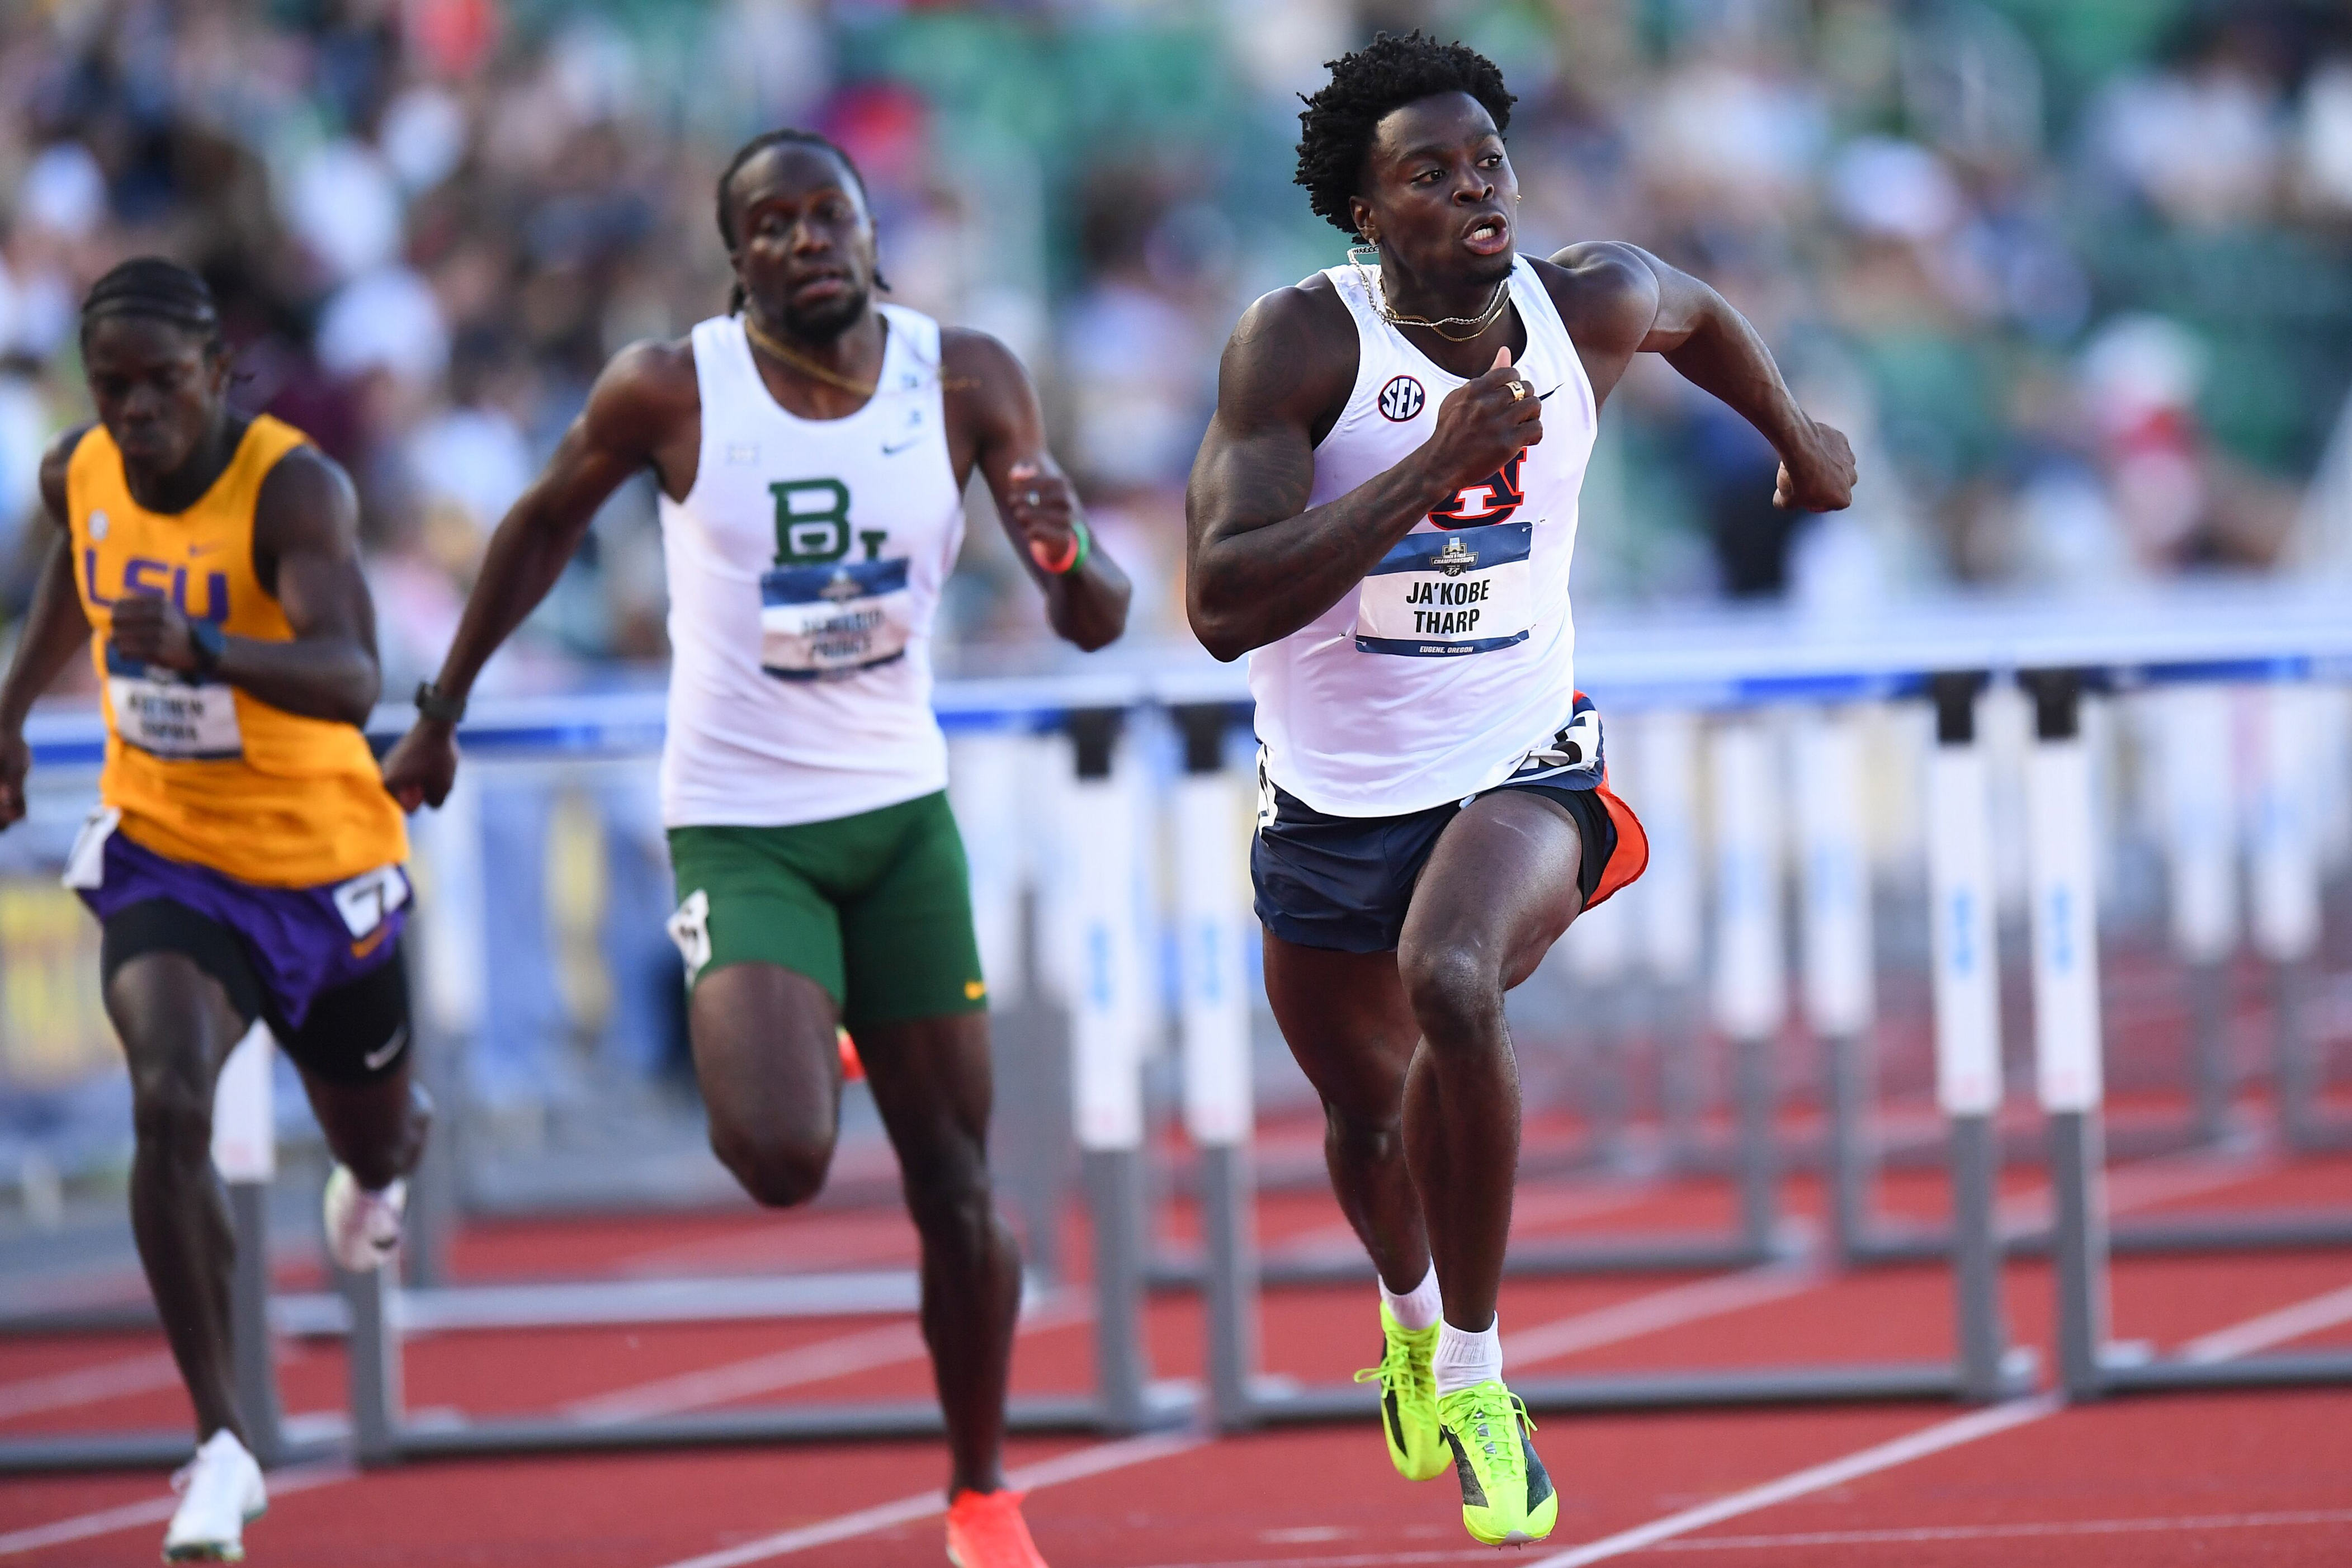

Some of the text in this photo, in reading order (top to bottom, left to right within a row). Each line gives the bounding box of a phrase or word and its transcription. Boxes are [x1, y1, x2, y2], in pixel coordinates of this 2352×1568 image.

[1381, 378, 1423, 419] SEC
[1433, 556, 1475, 564] CHAMPIONSHIPS
[84, 546, 228, 624] LSU
[1406, 579, 1490, 605] JA'KOBE
[1414, 608, 1480, 634] THARP
[350, 879, 386, 919] 7
